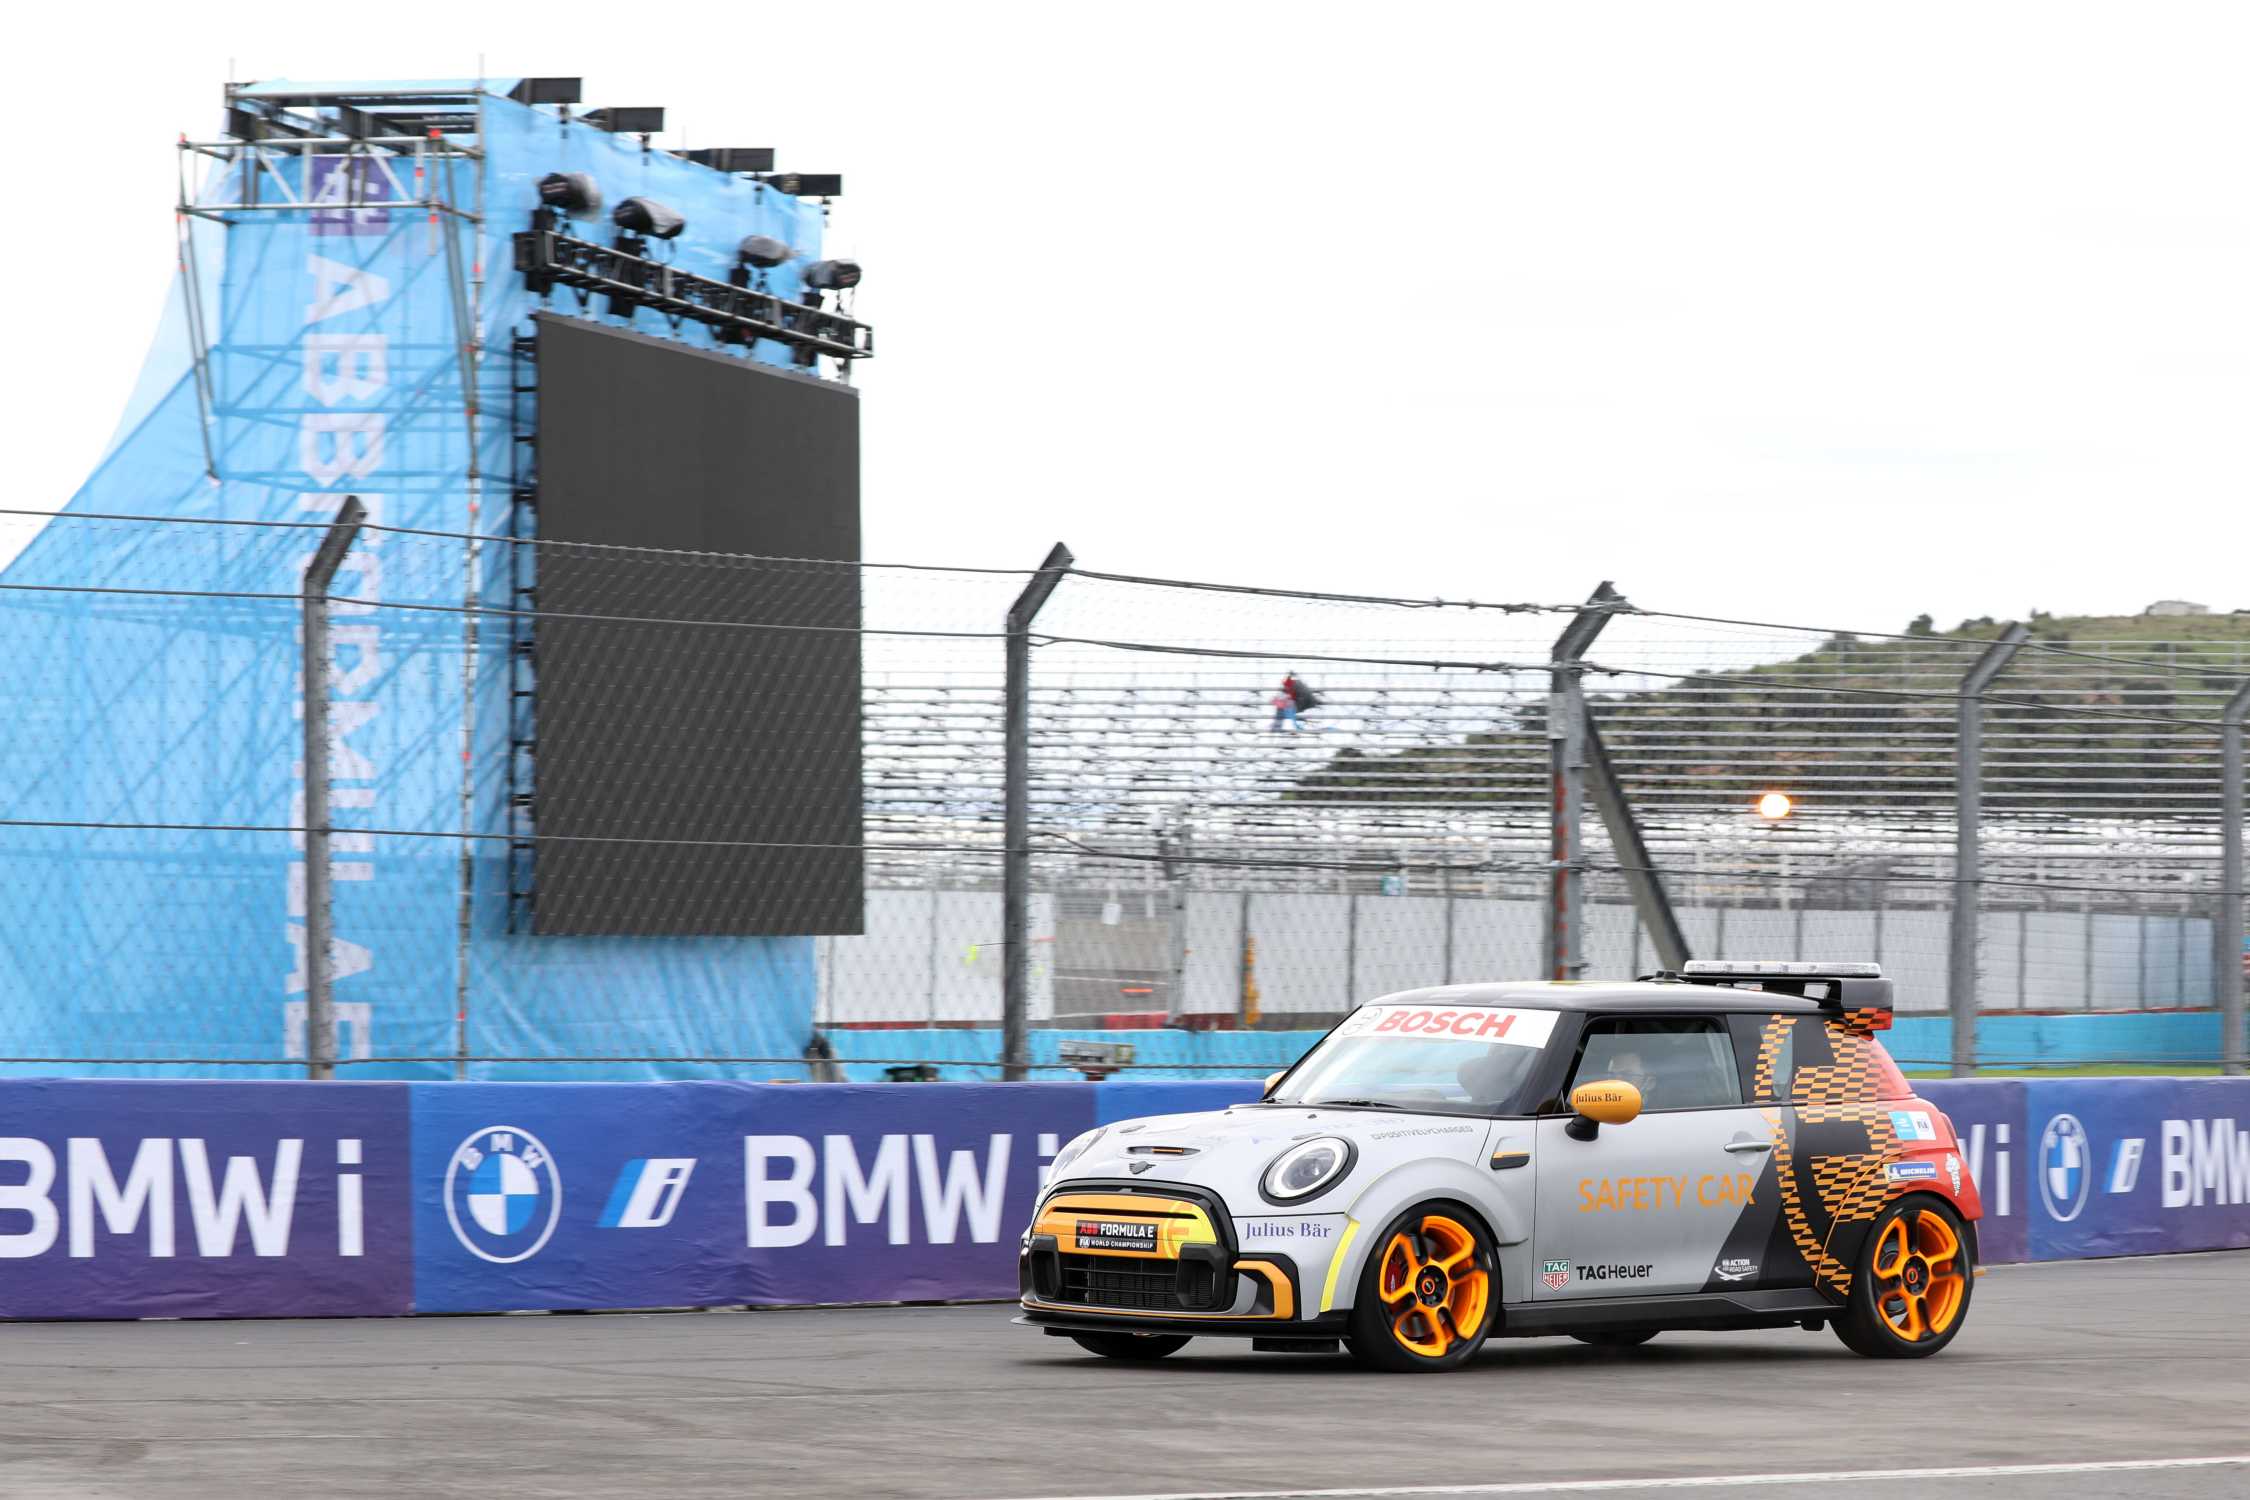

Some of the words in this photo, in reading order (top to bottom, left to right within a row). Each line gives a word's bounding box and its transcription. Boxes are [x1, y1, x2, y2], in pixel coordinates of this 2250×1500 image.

[1375, 1010, 1517, 1038] BOSCH
[1995, 1124, 2010, 1216] i
[0, 1137, 304, 1258] BMW
[336, 1139, 364, 1256] i
[744, 1133, 1012, 1248] BMW
[1578, 1176, 1688, 1213] SAFETY
[1698, 1173, 1756, 1206] CAR
[1080, 1222, 1099, 1234] ABB
[1100, 1223, 1145, 1237] FORMULA
[1148, 1226, 1155, 1238] E
[1246, 1222, 1295, 1240] Julius
[1300, 1222, 1332, 1238] Bär
[1111, 1240, 1154, 1249] CHAMPIONSHIP
[1545, 1262, 1568, 1272] TAG
[1543, 1273, 1569, 1287] HEUER
